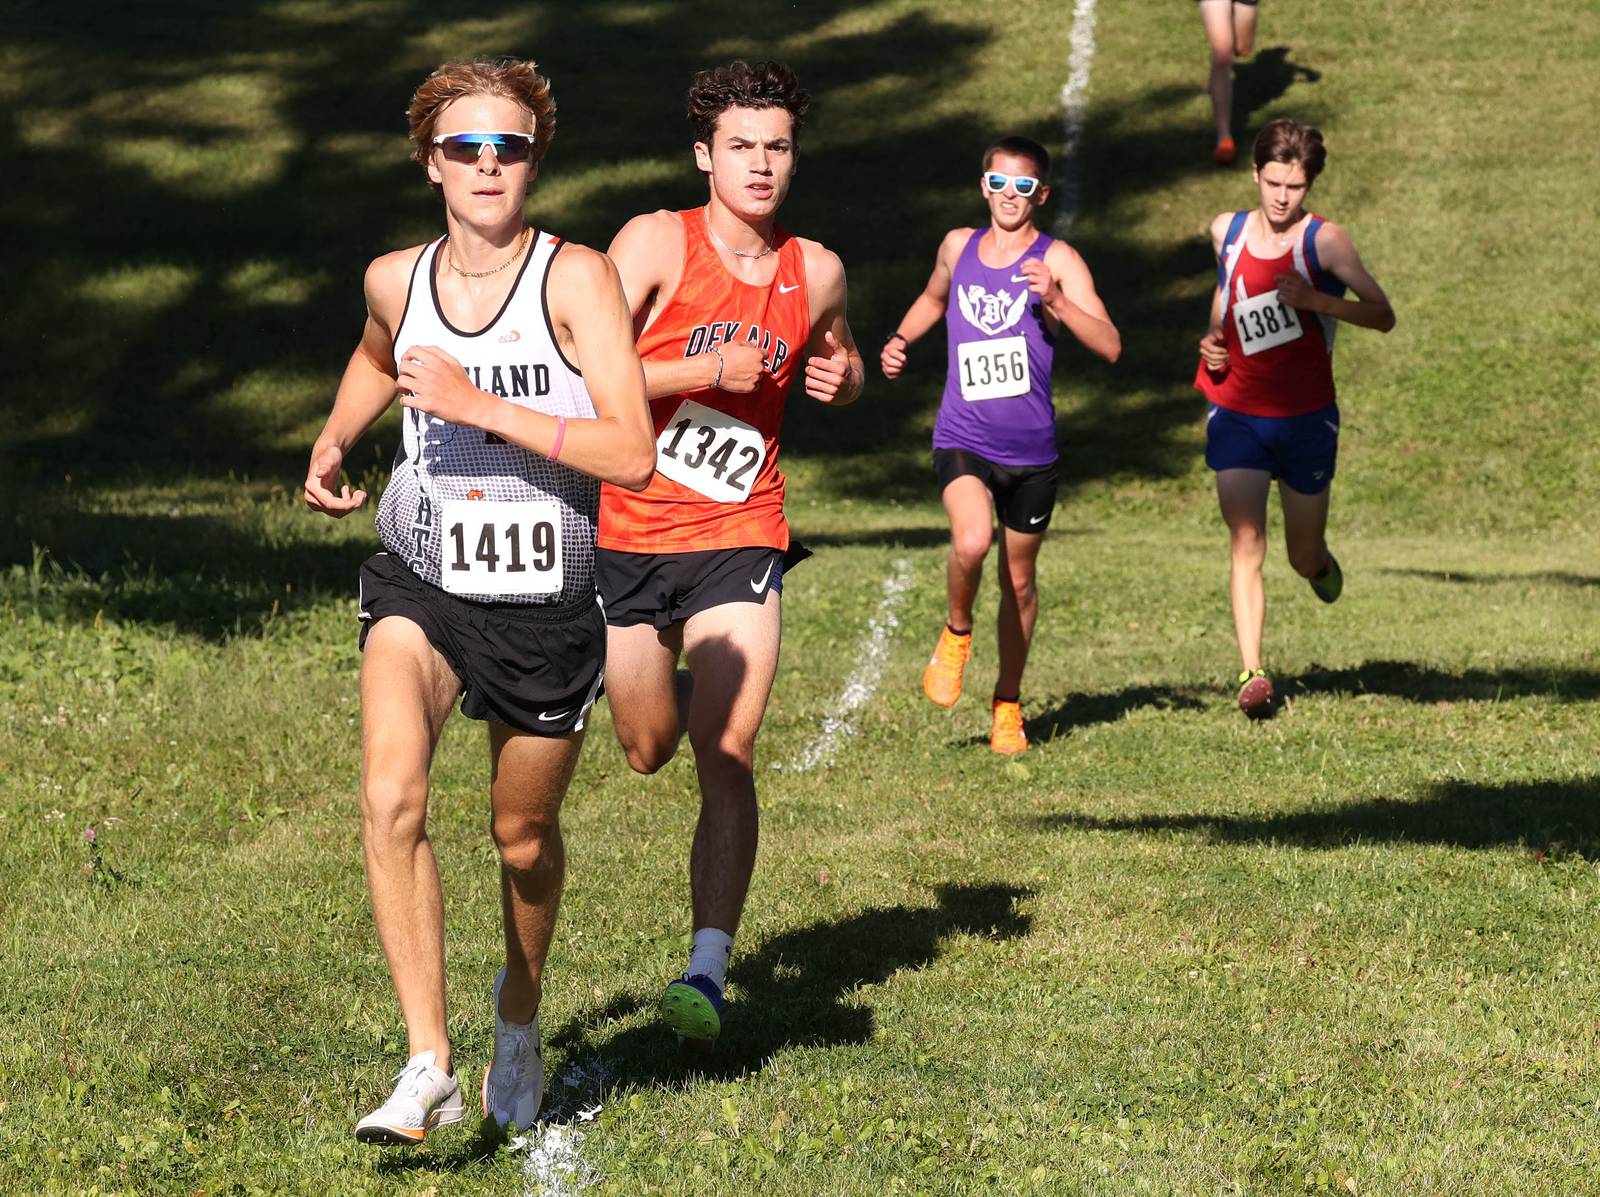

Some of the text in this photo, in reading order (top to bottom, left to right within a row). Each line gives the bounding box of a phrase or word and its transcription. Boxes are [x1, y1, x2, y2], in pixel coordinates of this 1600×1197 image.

[1239, 303, 1296, 343] 1381
[464, 363, 551, 398] LAND
[964, 350, 1024, 387] 1356
[661, 417, 760, 492] 1342
[450, 521, 556, 573] 1419
